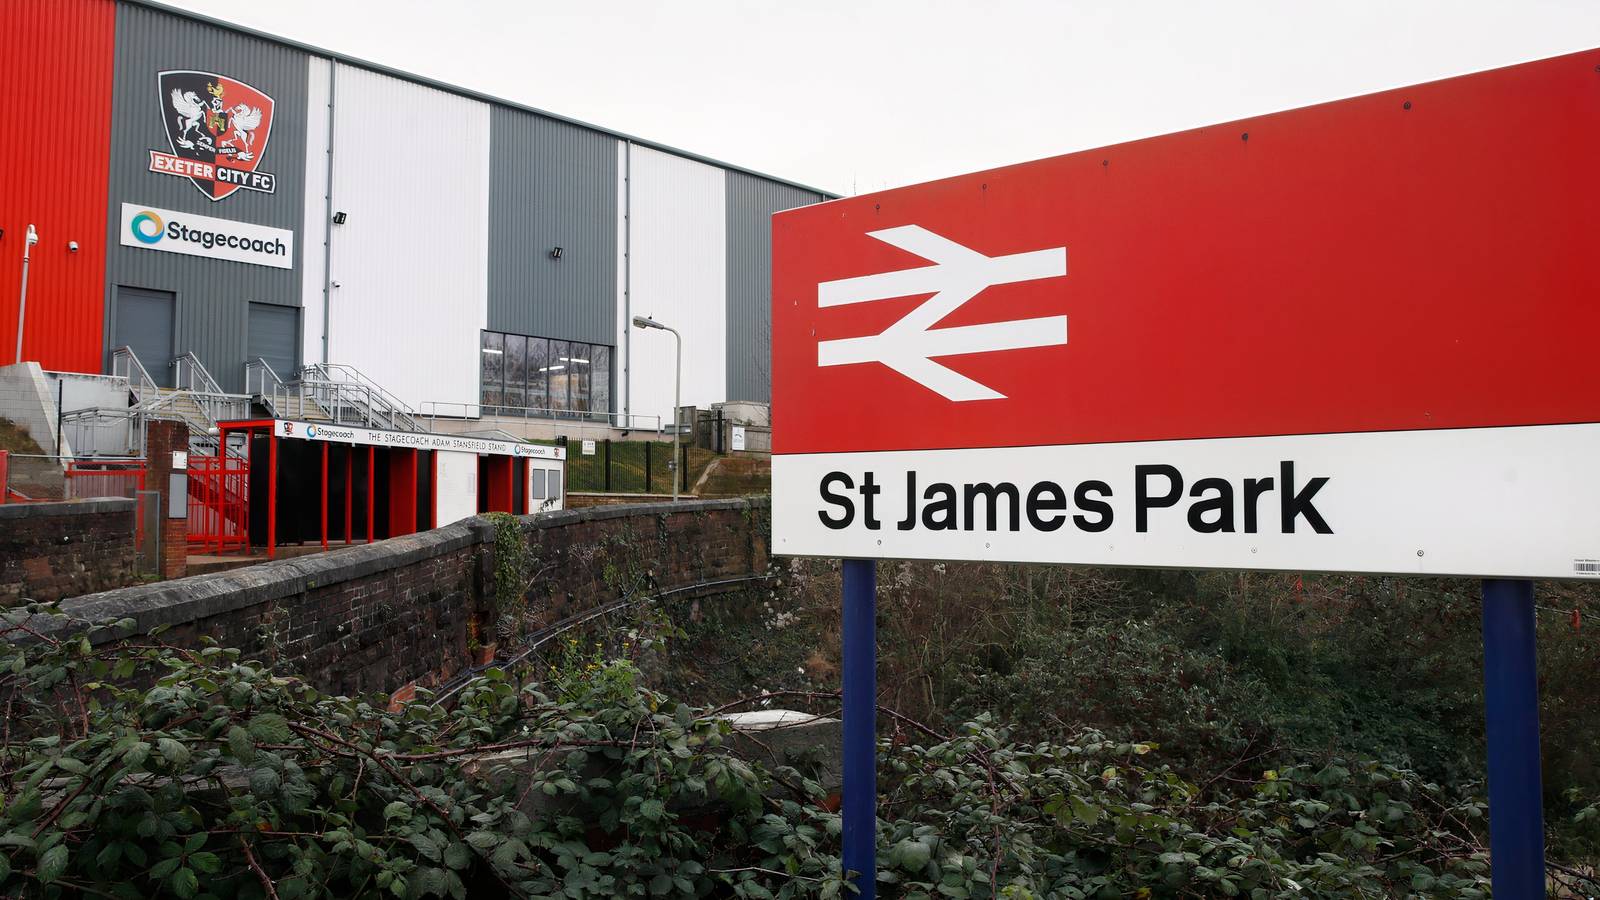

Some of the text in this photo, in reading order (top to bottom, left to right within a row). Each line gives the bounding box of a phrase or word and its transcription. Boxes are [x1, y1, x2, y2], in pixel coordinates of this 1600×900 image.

[154, 157, 271, 189] EXETER CITY FC
[167, 221, 286, 257] Stagecoach
[317, 427, 355, 439] Stagecoach
[368, 432, 506, 452] THE STAGECOACH ADAM STANSFIELD STAND
[521, 445, 546, 455] Stagecoach
[818, 460, 1335, 535] St James Park
